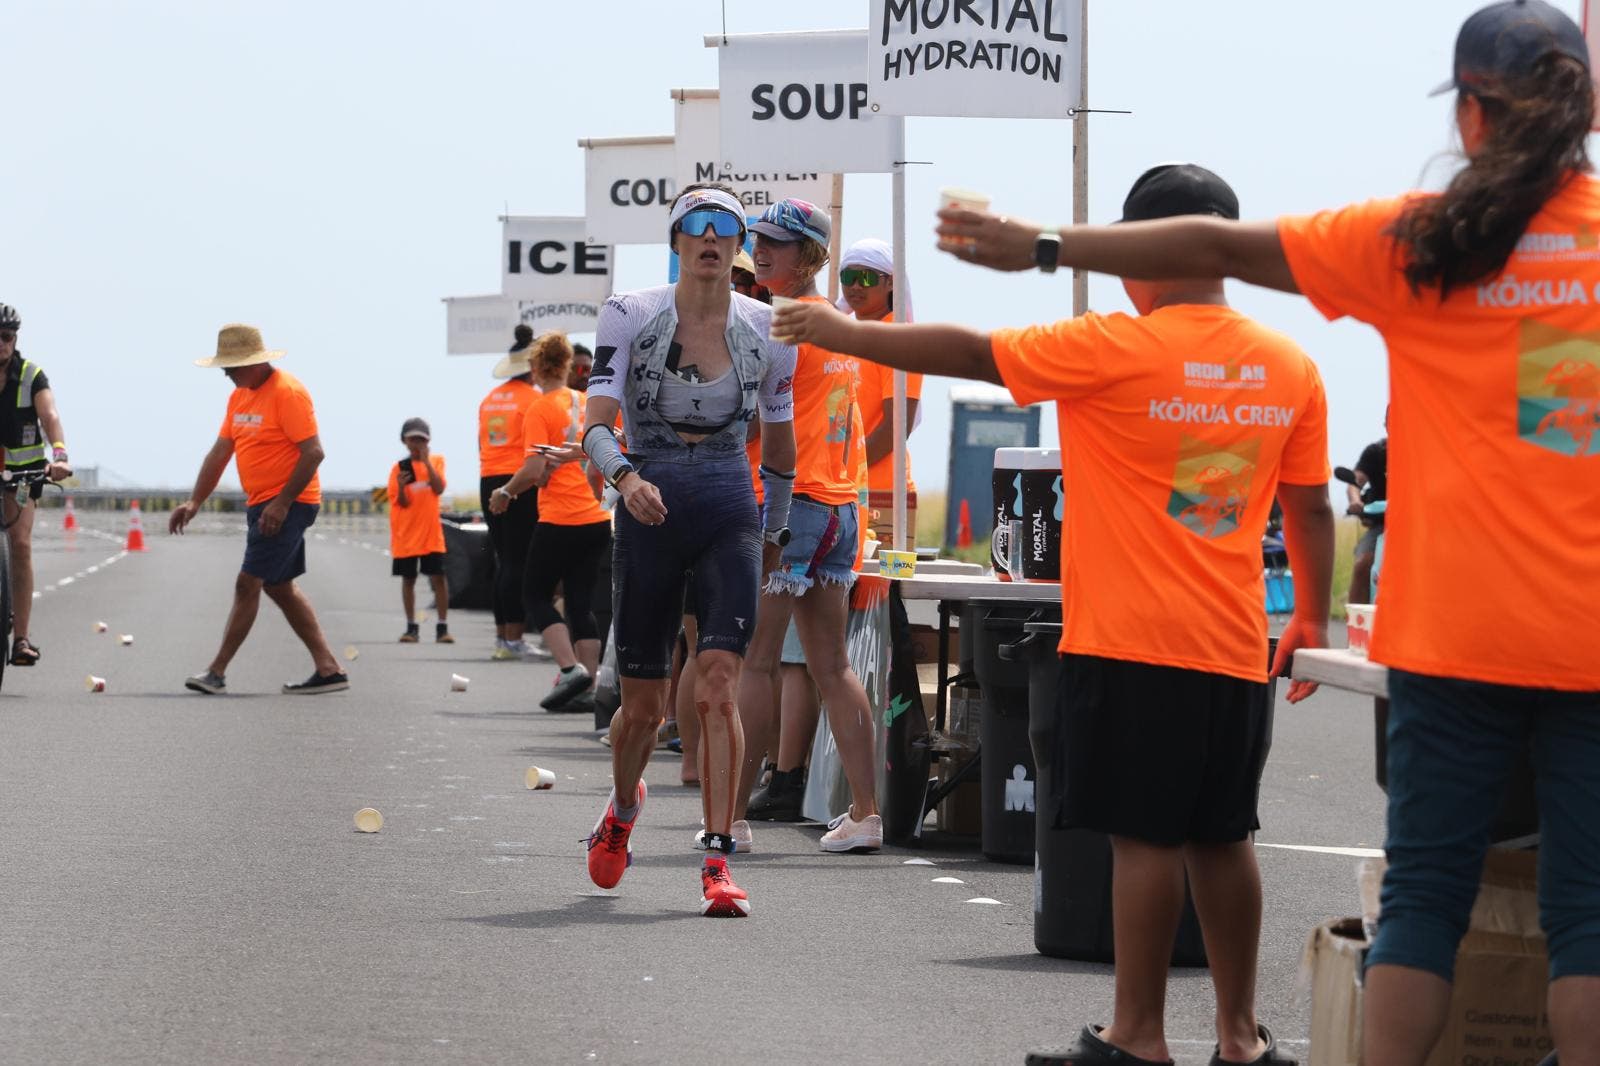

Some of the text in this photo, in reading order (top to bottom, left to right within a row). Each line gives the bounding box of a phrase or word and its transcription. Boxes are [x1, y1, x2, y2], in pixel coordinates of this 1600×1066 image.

[883, 39, 1062, 83] HYDRATION
[751, 82, 868, 121] SOUP
[610, 178, 673, 207] COL
[741, 190, 774, 206] GEL
[508, 240, 609, 275] ICE
[1476, 274, 1589, 307] KŌKUA
[520, 302, 599, 321] HYDRATION
[1148, 396, 1295, 427] KŌKUA CREW
[1032, 508, 1045, 562] MORTAL
